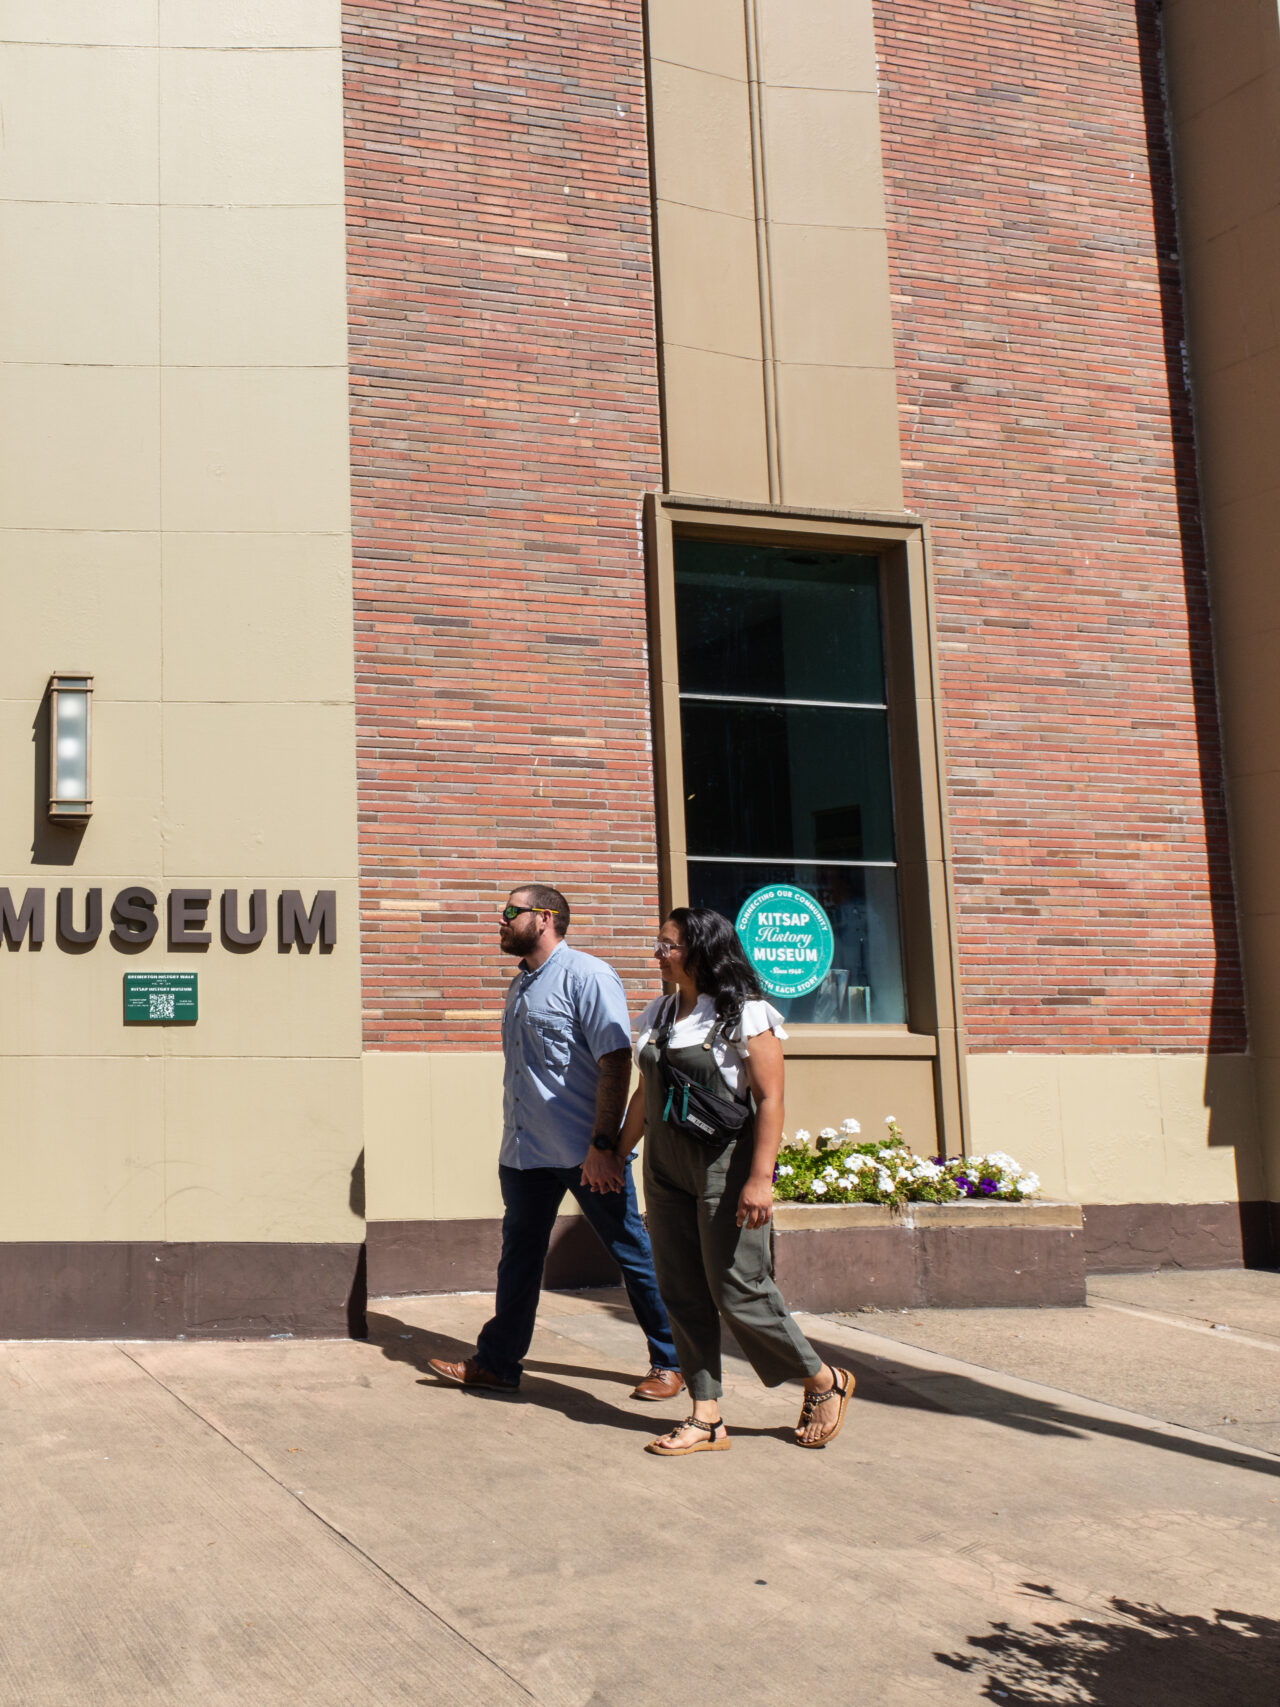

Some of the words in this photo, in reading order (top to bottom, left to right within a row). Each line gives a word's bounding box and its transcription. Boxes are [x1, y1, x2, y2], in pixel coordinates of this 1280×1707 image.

[739, 891, 775, 931] CONNECTING
[777, 890, 793, 898] OUR
[794, 893, 829, 932] COMMUNITY
[757, 912, 810, 926] KITSAP
[755, 926, 813, 948] History
[753, 947, 818, 962] MUSEUM
[775, 985, 796, 994] EACH
[797, 975, 818, 992] STORY
